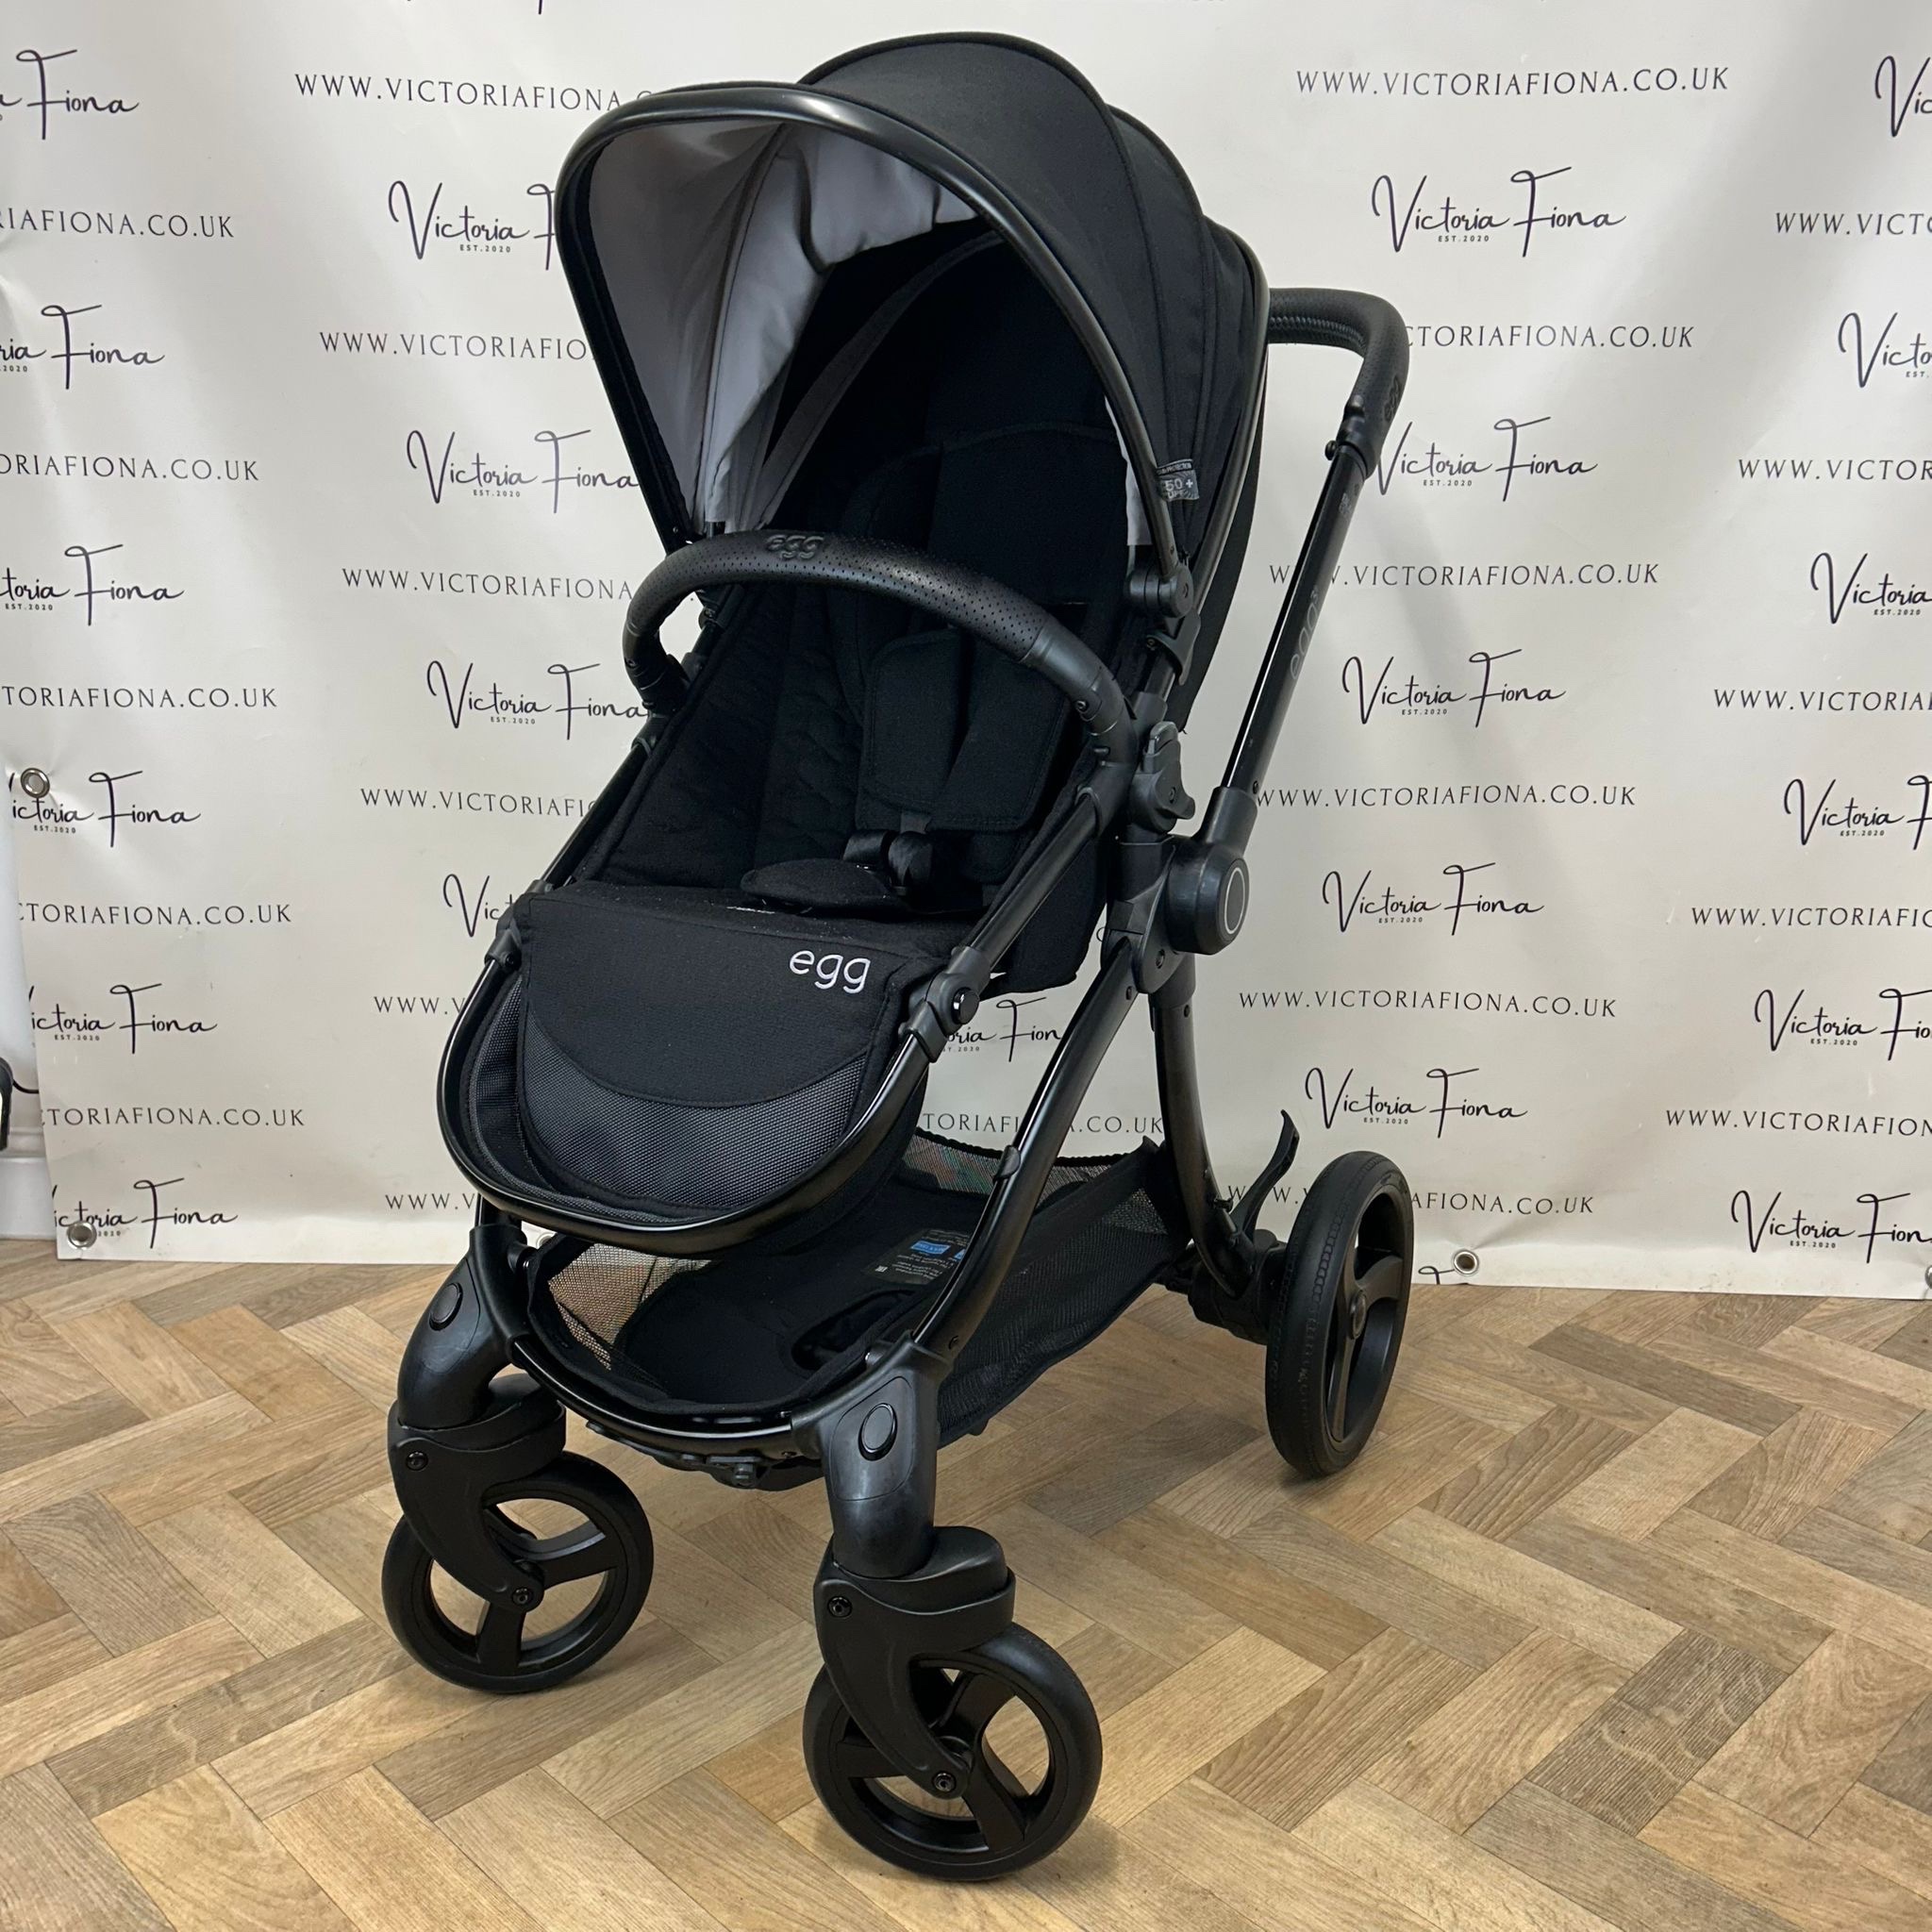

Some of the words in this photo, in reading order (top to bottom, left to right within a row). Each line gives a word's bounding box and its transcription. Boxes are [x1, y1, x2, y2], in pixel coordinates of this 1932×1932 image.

[16, 49, 140, 141] Fiona
[294, 74, 651, 111] WWW.VICTORIAFIONA
[1297, 67, 1728, 95] WWW.VICTORIAFIONA.CO.UK
[388, 180, 529, 260] Victoria
[1372, 175, 1509, 253] Victoria
[1510, 166, 1626, 258] Fiona
[458, 243, 511, 254] EST.2020
[1437, 234, 1490, 243] EST.2020
[41, 305, 165, 390] Fiona
[1407, 325, 1694, 347] TORIAFIONA.CO.UK
[407, 430, 538, 504] Victoria
[534, 429, 639, 513] Fiona
[1493, 416, 1598, 502] Fiona
[472, 489, 521, 498] EST.2020
[1423, 478, 1473, 488] EST.2020
[64, 544, 185, 626] Fiona
[1267, 563, 1658, 586] W.VICTORIAFIONA.CO.UK
[4, 602, 54, 611] EST.2020
[426, 660, 552, 729] Victoria
[546, 662, 645, 741] Fiona
[1341, 657, 1467, 724] Victoria
[1469, 649, 1566, 728] Fiona
[490, 715, 536, 725] EST.2020
[1401, 707, 1448, 716] EST.2020
[8, 771, 94, 824] ictoria
[89, 771, 201, 847] Fiona
[1257, 785, 1635, 807] WWW.VICTORIAFIONA.CO.UK
[1784, 778, 1905, 845] Victoria
[1839, 829, 1886, 838] EST.2020
[1322, 870, 1441, 933] Victoria
[1442, 862, 1544, 936] Fiona
[1377, 916, 1424, 924] EST.2020
[789, 949, 871, 994] egg
[28, 985, 116, 1033] ictoria
[109, 983, 217, 1054] Fiona
[1240, 990, 1616, 1017] WWW.VICTORIAFIONA.CO.UK
[1754, 989, 1877, 1052] Victoria
[996, 997, 1061, 1062] Fion
[1809, 1037, 1858, 1047] EST.2020
[41, 1108, 304, 1127] TORIAFIONA.CO.UK
[1305, 1067, 1426, 1129] Victoria
[1426, 1068, 1528, 1139] Fiona
[1363, 1116, 1409, 1125] EST.2020
[52, 1184, 138, 1228] ictoria
[133, 1177, 238, 1249] Fiona
[1731, 1190, 1856, 1253] Victoria
[1857, 1192, 1932, 1264] Fion
[1789, 1239, 1837, 1249] EST.2020
